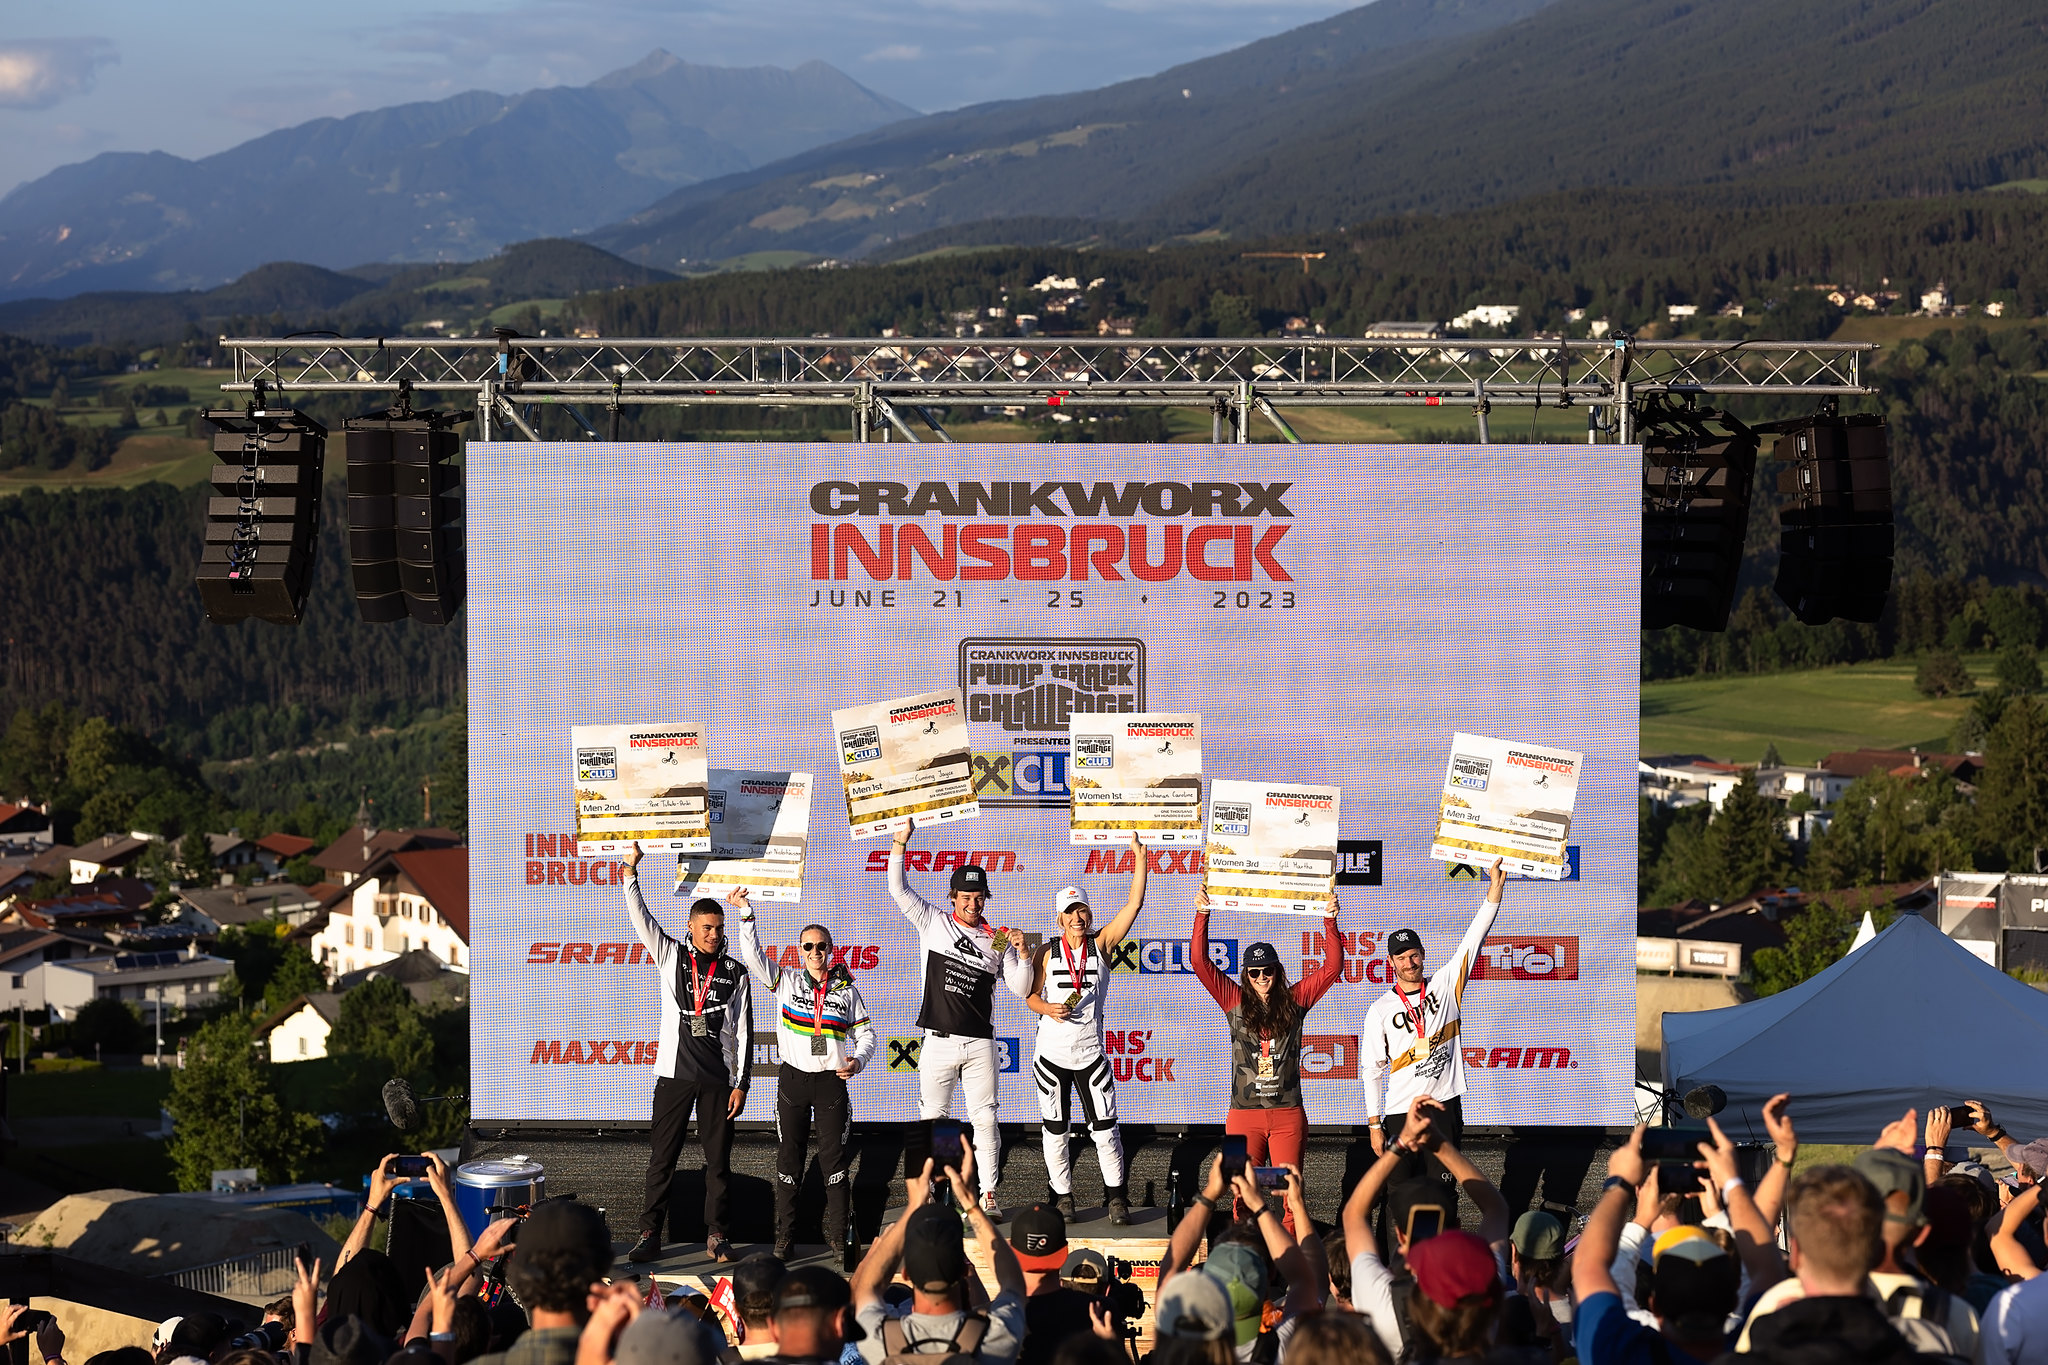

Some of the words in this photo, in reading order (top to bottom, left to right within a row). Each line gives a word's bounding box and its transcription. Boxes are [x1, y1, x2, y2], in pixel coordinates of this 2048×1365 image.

[809, 480, 1295, 517] CRANKWORX
[810, 523, 1295, 582] INNSBRUCK
[809, 590, 897, 608] JUNE
[932, 591, 964, 608] 21
[1047, 591, 1085, 609] 25
[1212, 591, 1296, 609] 2023
[969, 650, 1056, 661] CRANKWORX
[1058, 650, 1135, 661] INNSBRUCK
[969, 663, 1044, 690] PUMP
[889, 698, 955, 715] CRANKWORX
[890, 704, 957, 724] INNSBRUCK
[1128, 728, 1194, 736] INNSBRUCK
[630, 738, 698, 748] INNSBRUCK
[1013, 737, 1070, 746] PRESENTED
[855, 748, 878, 761] CLUB
[1508, 750, 1575, 766] CRANKWORX
[1086, 758, 1110, 766] CLUB
[1506, 756, 1574, 774] INNSBRUCK
[590, 770, 614, 778] CLUB
[741, 780, 806, 788] CRANKWORX
[1461, 776, 1485, 788] CLUB
[740, 786, 805, 796] INNSBRUCK
[852, 786, 871, 795] Men
[872, 783, 883, 792] 1st
[1266, 792, 1333, 800] CRANKWORX
[583, 804, 602, 812] Men
[604, 804, 620, 812] 2nd
[1266, 798, 1332, 809] INNSBRUCK
[1446, 810, 1466, 819] Men
[1467, 812, 1480, 822] 3rd
[1223, 824, 1246, 834] CLUB
[865, 850, 1016, 873] SRAM
[1212, 858, 1244, 868] Women
[530, 1040, 659, 1064] MAXXIS
